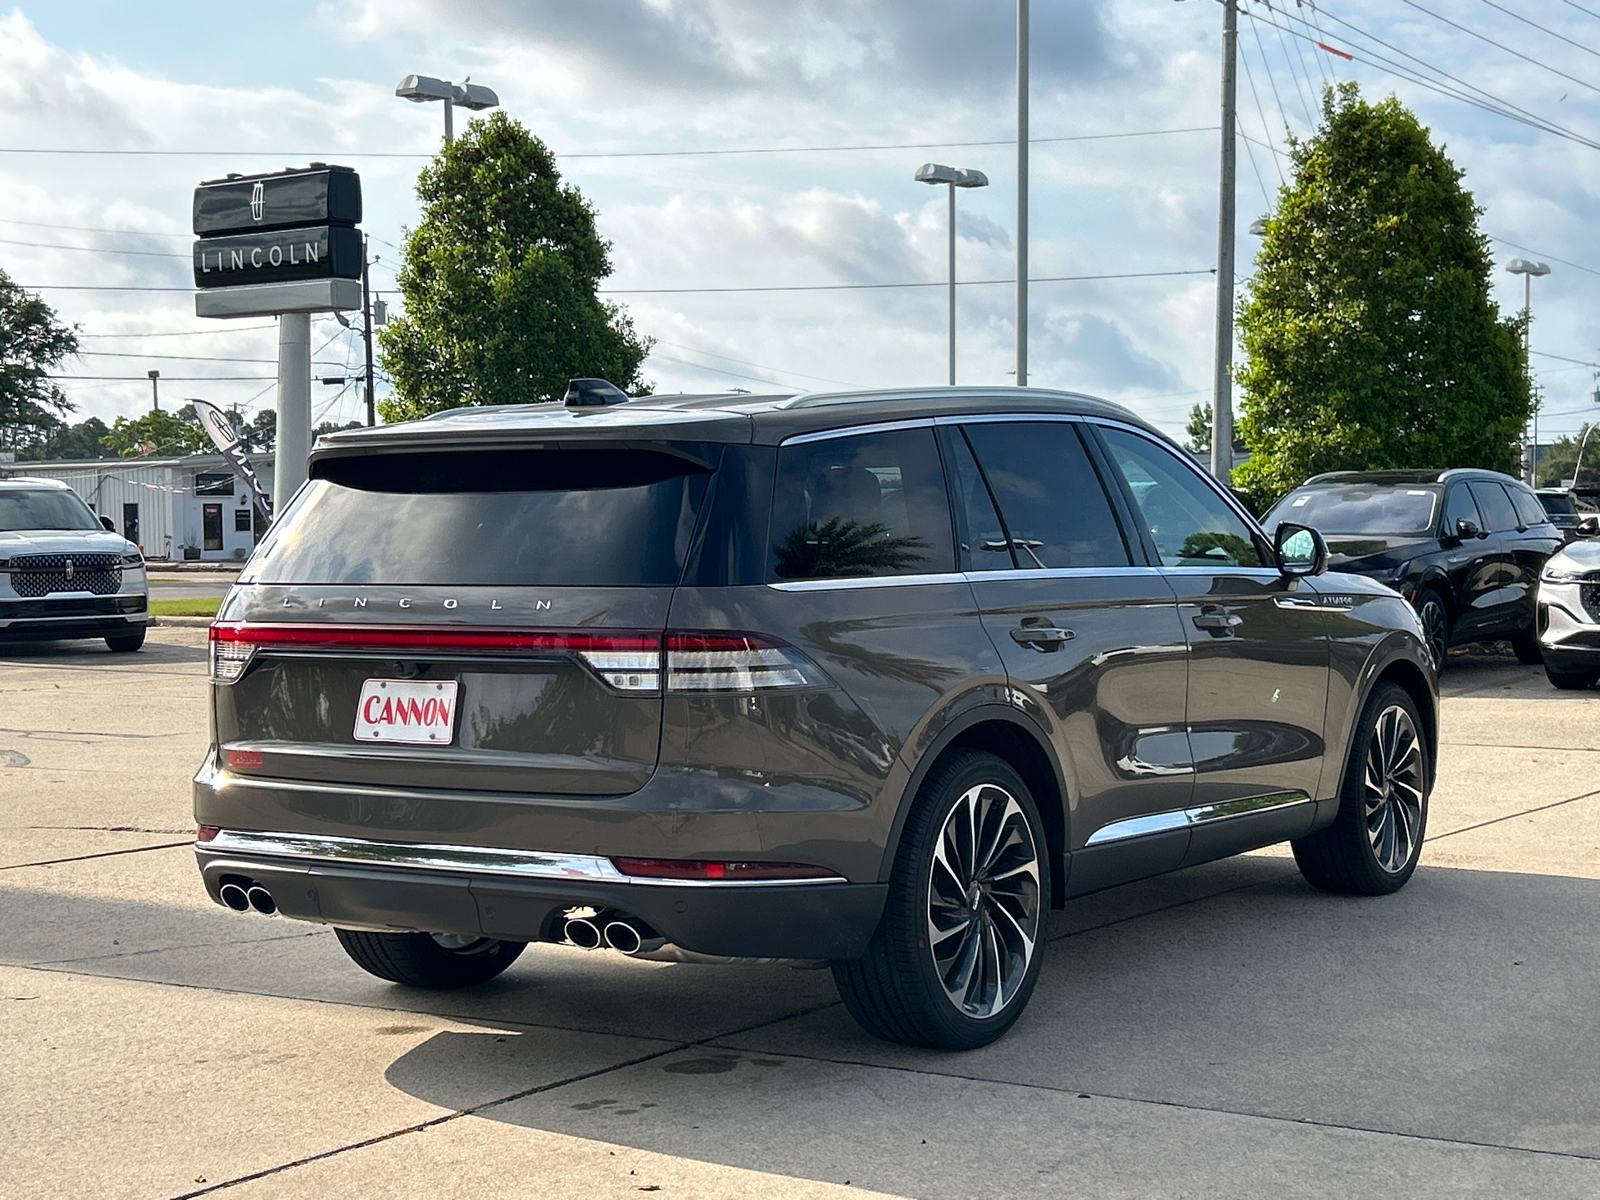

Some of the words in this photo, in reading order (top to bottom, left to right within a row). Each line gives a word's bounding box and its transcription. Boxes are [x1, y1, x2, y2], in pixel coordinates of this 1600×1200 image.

[202, 242, 319, 273] LINCOLN
[282, 597, 551, 610] LINCOLN
[363, 695, 452, 727] CANNON
